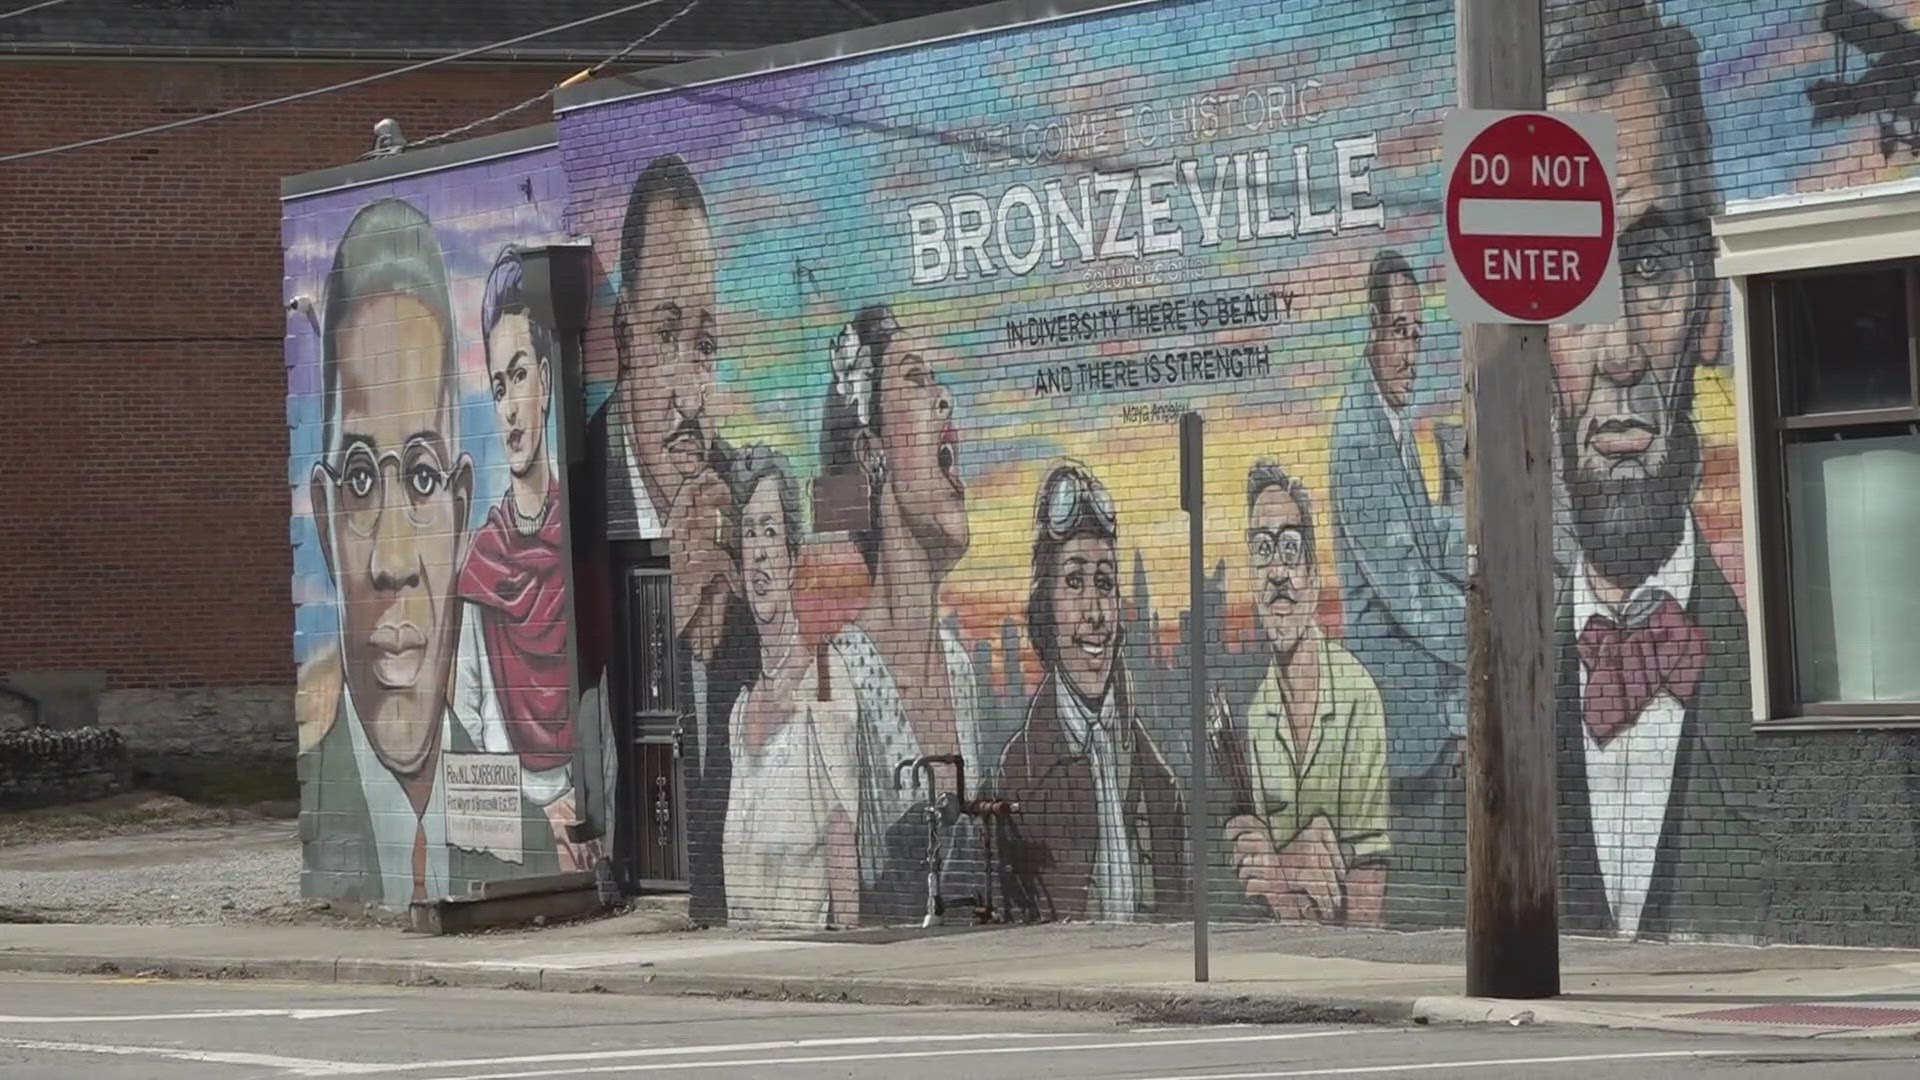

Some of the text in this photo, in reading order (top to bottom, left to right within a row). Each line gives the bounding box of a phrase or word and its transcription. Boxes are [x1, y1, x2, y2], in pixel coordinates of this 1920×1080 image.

[959, 80, 1326, 170] WELCOME TO HISTORIC
[1470, 154, 1590, 187] DO NOT
[907, 132, 1385, 285] BRONZEVILLE
[1483, 249, 1581, 281] ENTER
[1006, 290, 1296, 349] IN DIVERSITY THERE IS BEAUTY
[1034, 345, 1272, 397] AND THERE IS STRENGTH
[1122, 404, 1149, 424] Maya
